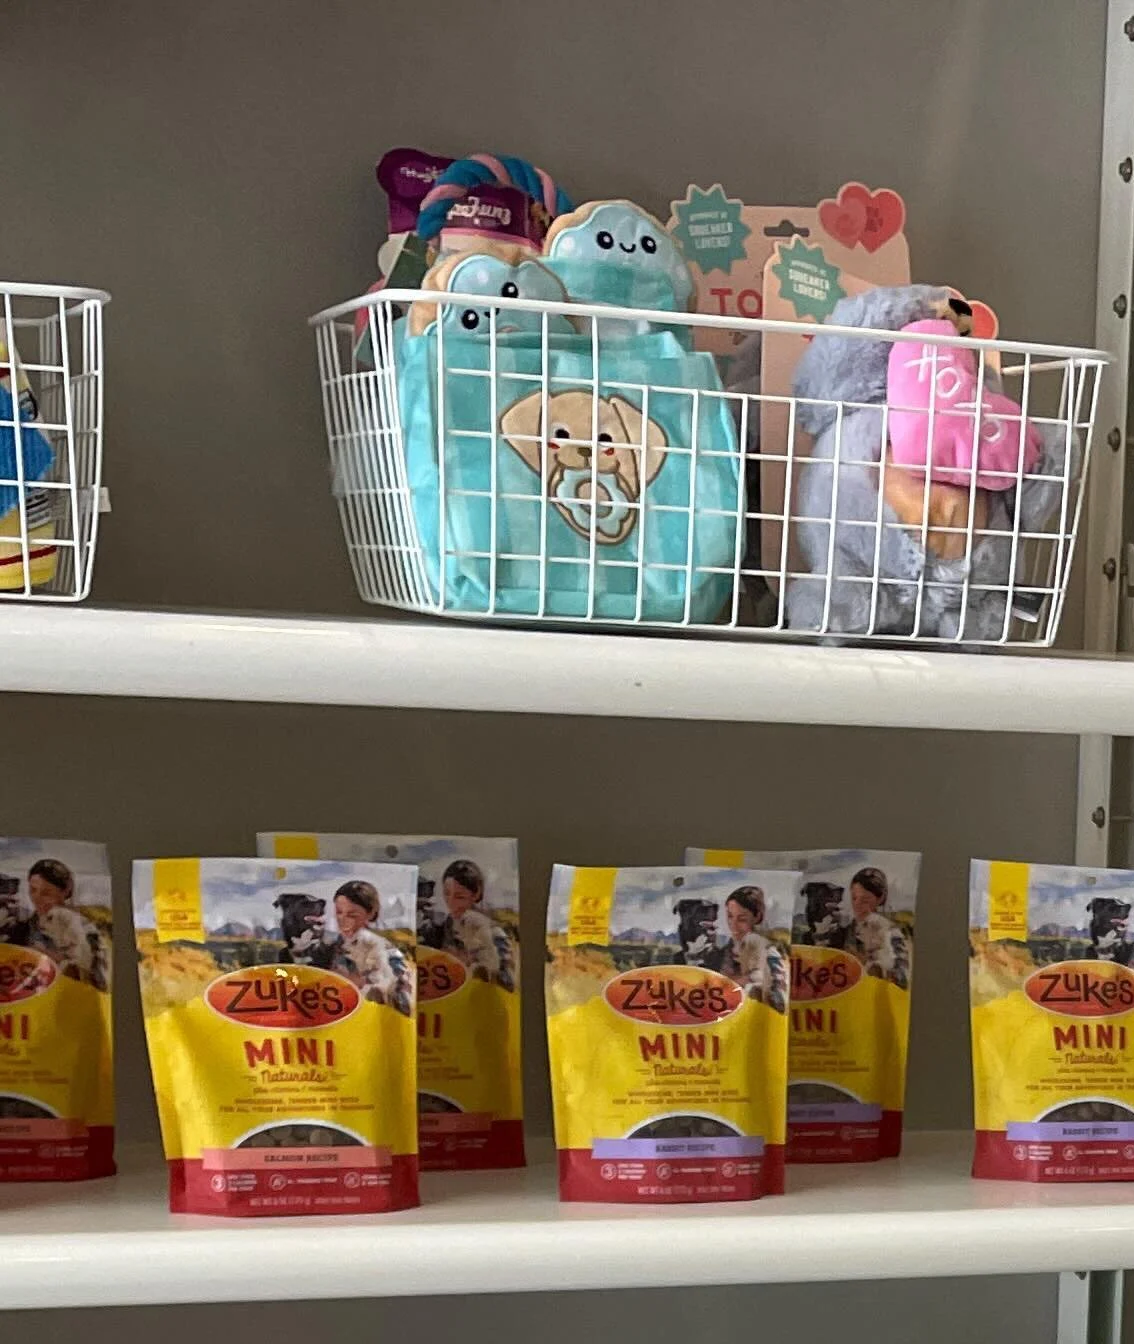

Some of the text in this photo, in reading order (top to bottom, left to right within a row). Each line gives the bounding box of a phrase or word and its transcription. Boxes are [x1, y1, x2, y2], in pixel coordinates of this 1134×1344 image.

[225, 974, 345, 1020] Zuke's
[621, 978, 729, 1019] Zuke's
[1039, 973, 1134, 1008] Zuke's
[243, 1037, 335, 1068] MINI
[638, 1033, 720, 1062] MINI
[1053, 1024, 1127, 1051] MINI
